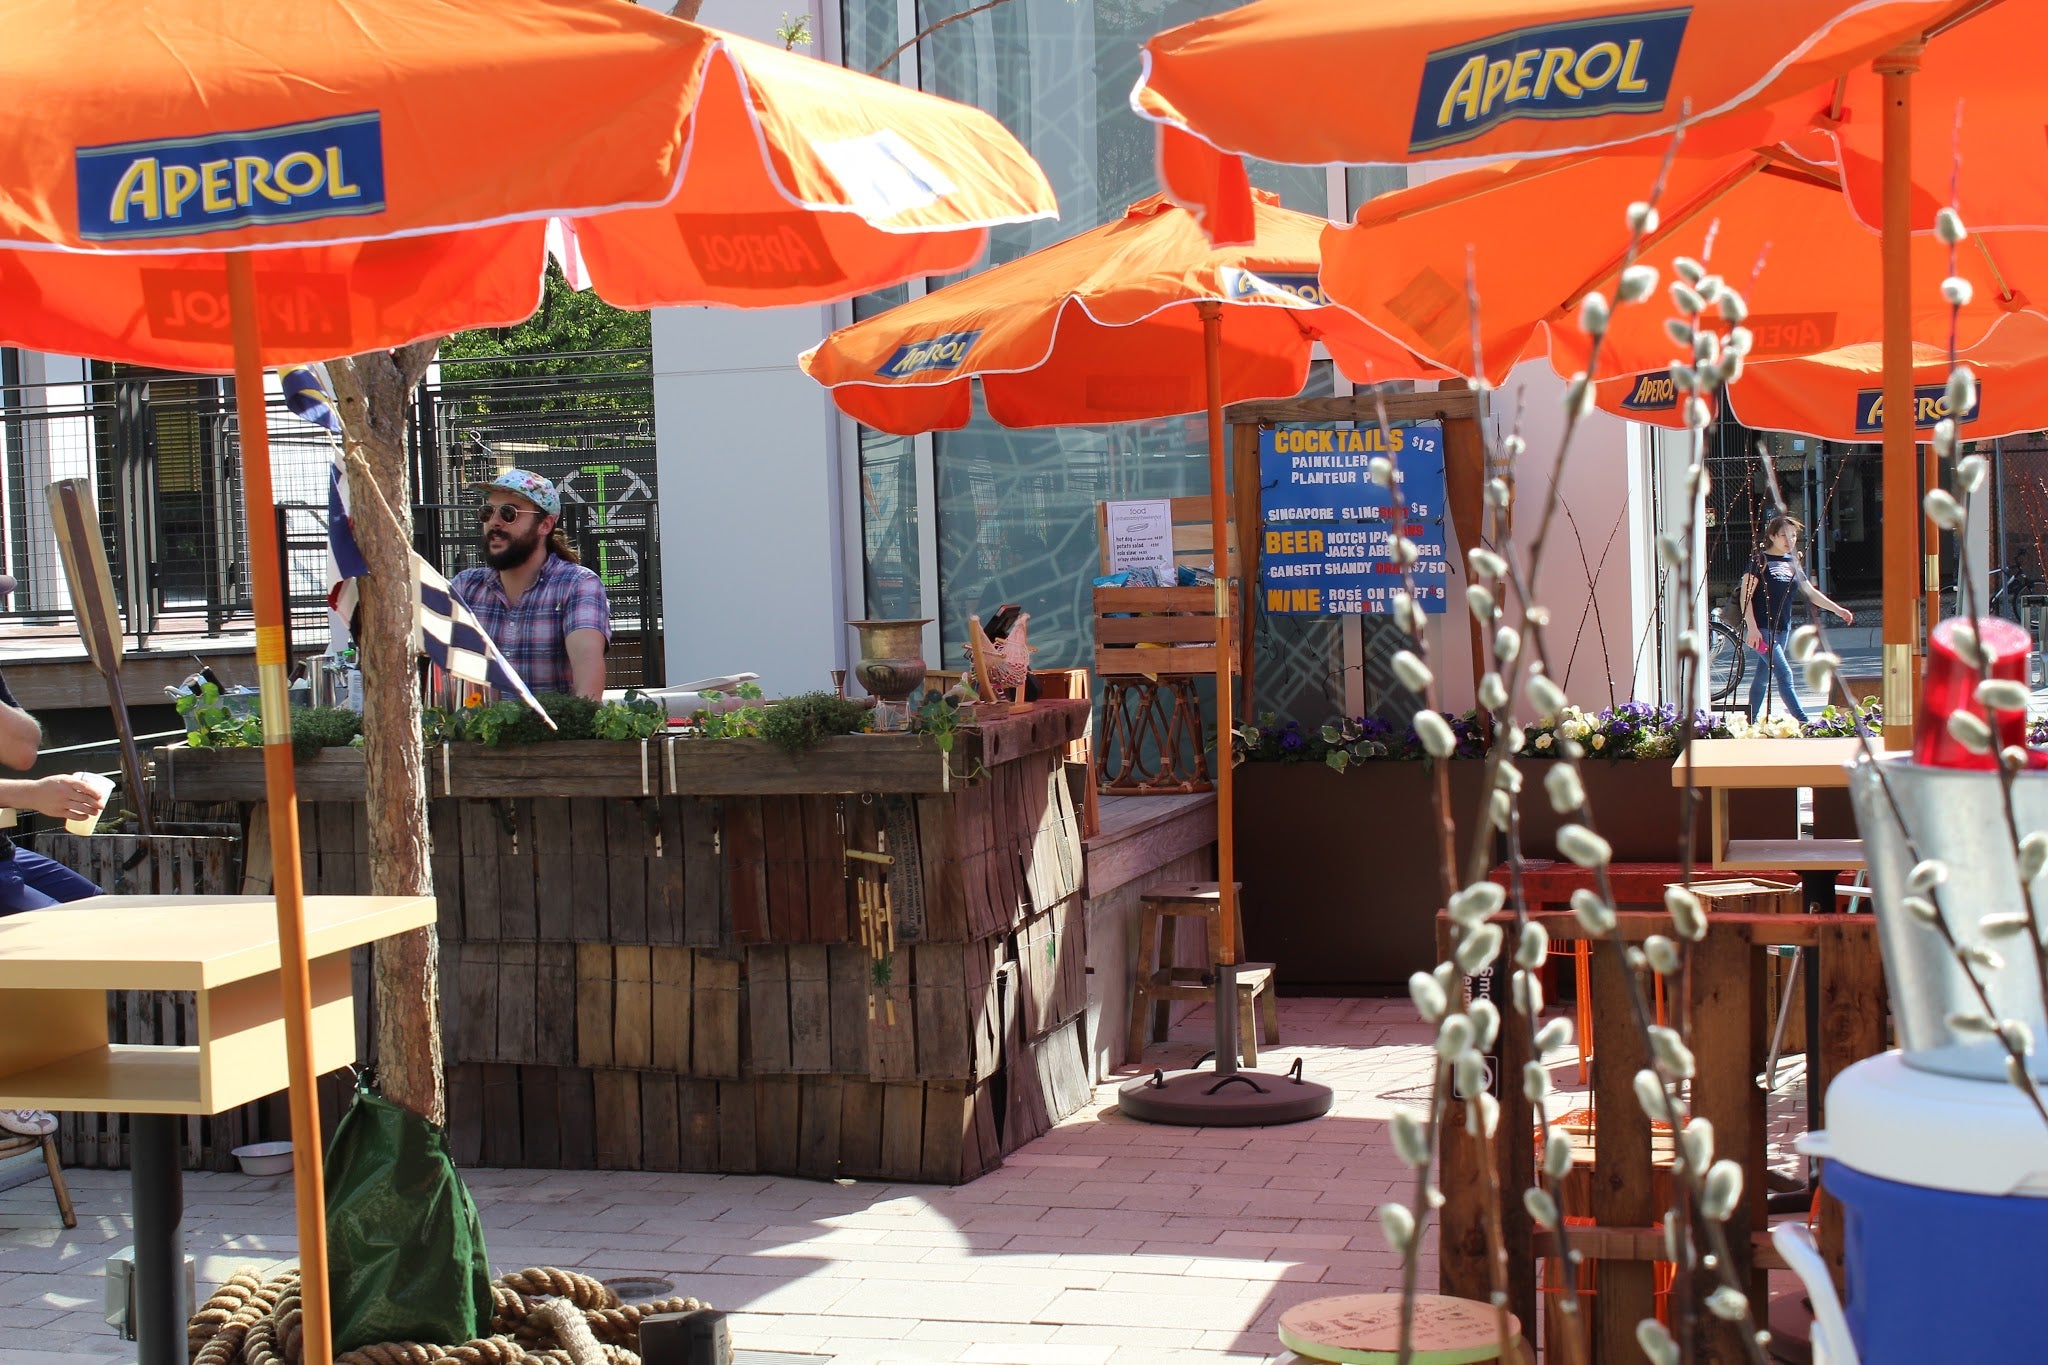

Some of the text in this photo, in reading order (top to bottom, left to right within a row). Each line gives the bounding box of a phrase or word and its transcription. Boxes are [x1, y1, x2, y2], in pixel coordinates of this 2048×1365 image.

[1437, 38, 1648, 127] APEROL
[109, 146, 361, 223] APEROL
[891, 341, 967, 373] APROL
[1633, 376, 1675, 403] APEROL
[1274, 429, 1435, 453] COCKTAILS $12
[1292, 454, 1368, 469] PAINKILLER
[1291, 471, 1356, 484] PLANTEUR
[1268, 507, 1334, 521] SINGAPORE
[1411, 502, 1428, 517] $5
[1265, 529, 1324, 554] BEER
[1327, 531, 1389, 544] NOTCH IPA
[1325, 545, 1365, 557] JACK'S
[1369, 545, 1395, 557] ABB
[1324, 562, 1372, 575] SHANDY
[1328, 585, 1361, 600] ROSÉ
[1367, 588, 1385, 600] ON
[1328, 600, 1385, 614] SANGRIA
